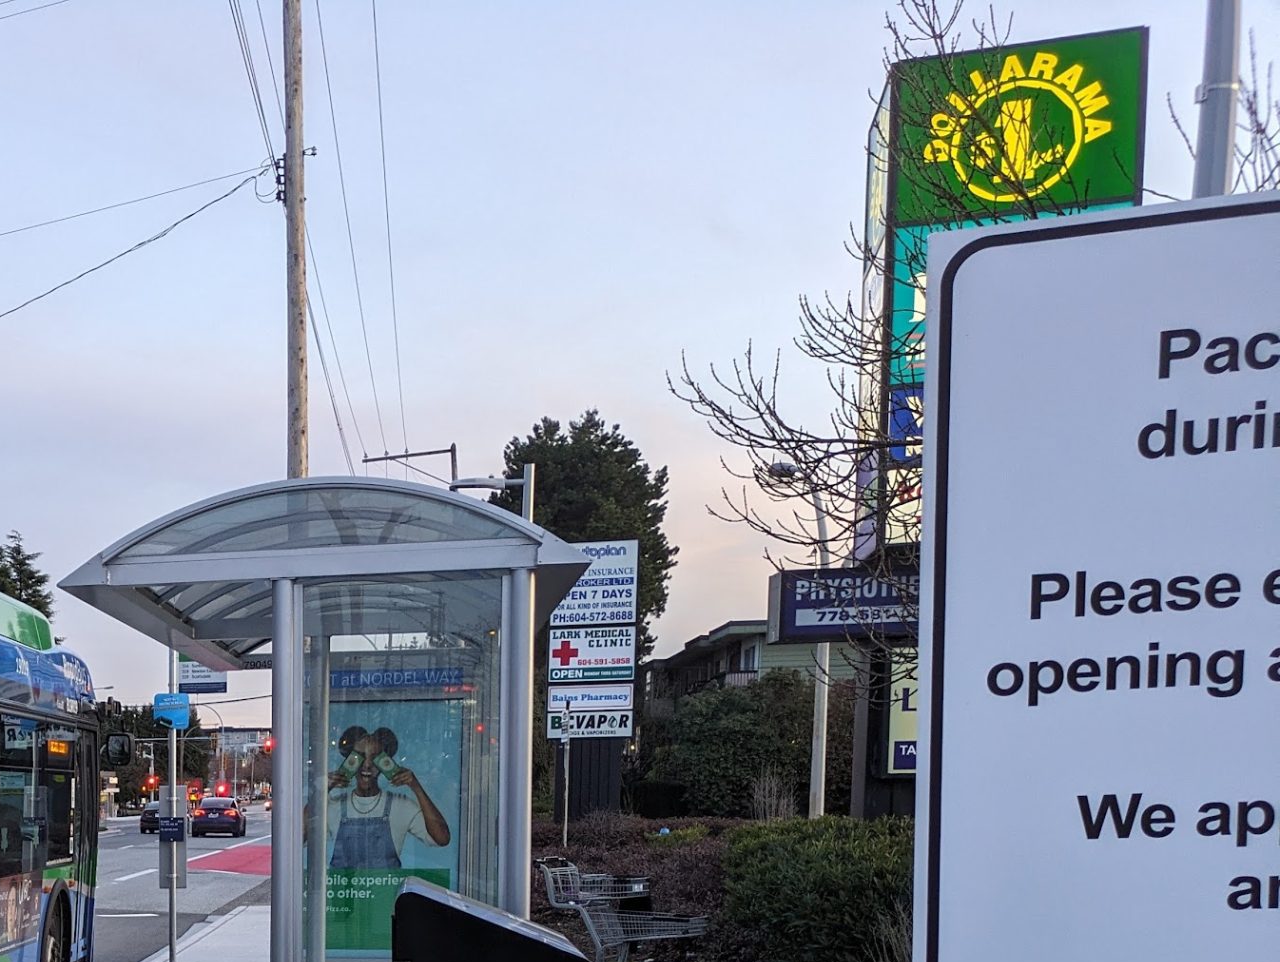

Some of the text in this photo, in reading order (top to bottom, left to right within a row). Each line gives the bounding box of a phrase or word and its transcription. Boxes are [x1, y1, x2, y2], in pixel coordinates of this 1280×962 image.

[924, 52, 1112, 163] DOLLARAMA
[1158, 328, 1280, 379] Pac
[588, 567, 634, 577] INSURANCE
[576, 578, 611, 587] ROKER
[566, 589, 633, 600] EN 7 DAYS
[1030, 570, 1241, 620] Please
[601, 601, 632, 609] INSURANCE
[552, 629, 632, 639] LARK MEDICAL
[588, 639, 631, 648] CLINIC
[341, 674, 356, 686] at
[360, 672, 419, 685] NORDEL
[424, 670, 458, 683] WAY
[552, 669, 583, 679] OPEN
[986, 643, 1245, 707] opening
[552, 694, 629, 702] Bains Pharmacy
[1077, 794, 1280, 847] We ap
[337, 888, 375, 899] other.
